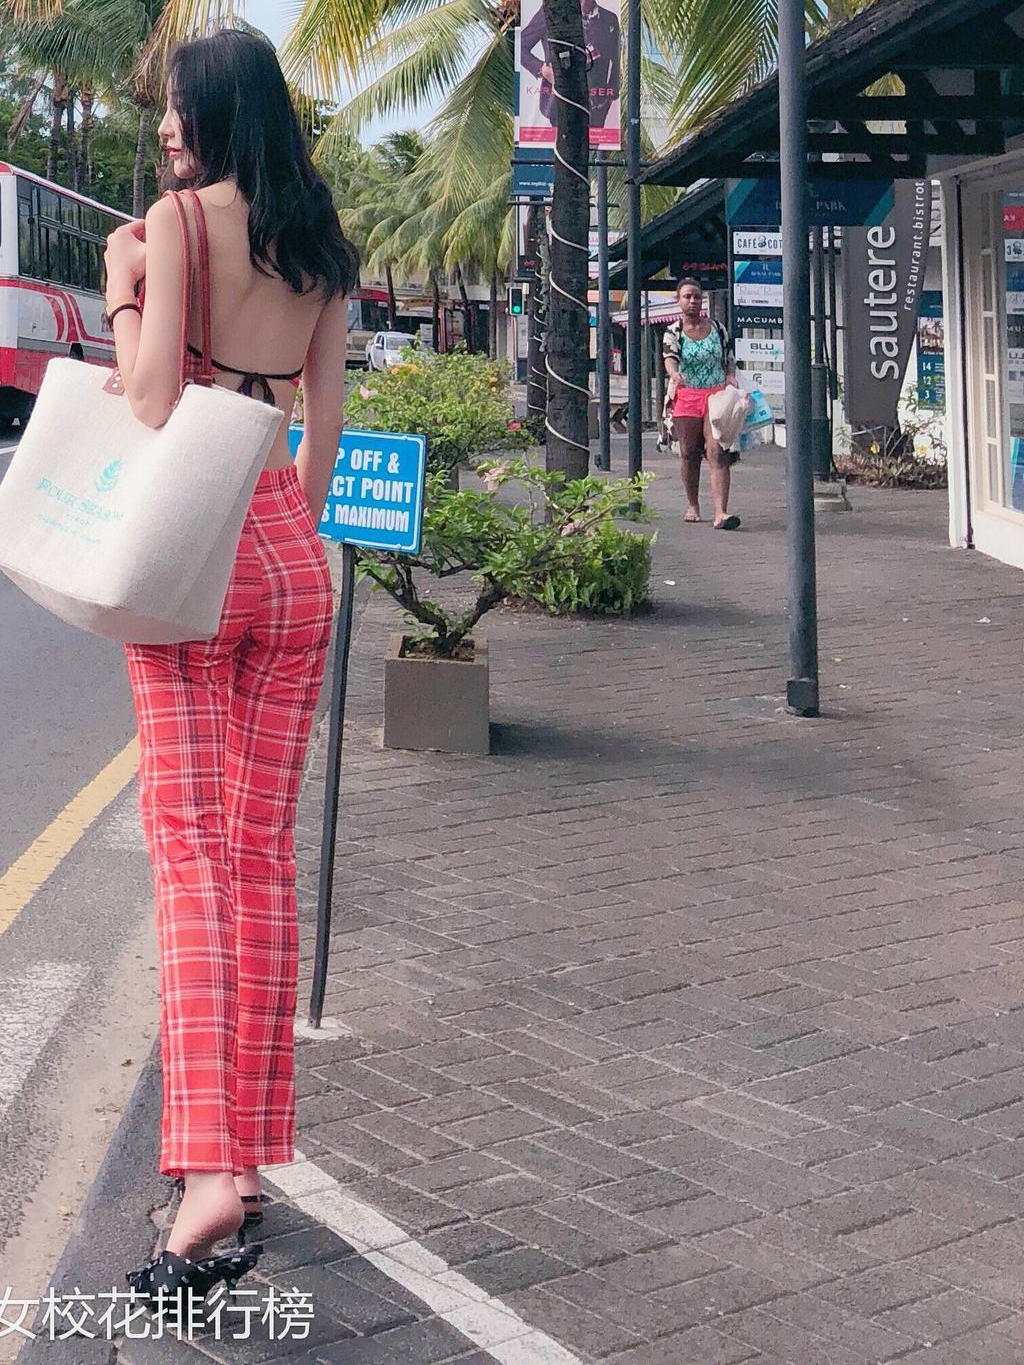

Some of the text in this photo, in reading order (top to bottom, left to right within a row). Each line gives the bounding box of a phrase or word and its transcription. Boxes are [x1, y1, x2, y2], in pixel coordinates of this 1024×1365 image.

[737, 236, 782, 249] CAFÉ COT
[864, 226, 899, 380] sautere
[737, 316, 783, 324] MACUMB
[750, 342, 774, 350] BLU
[350, 448, 383, 471] OFF
[387, 452, 400, 474] &
[360, 477, 414, 503] POINT
[334, 503, 410, 533] MAXIMUM
